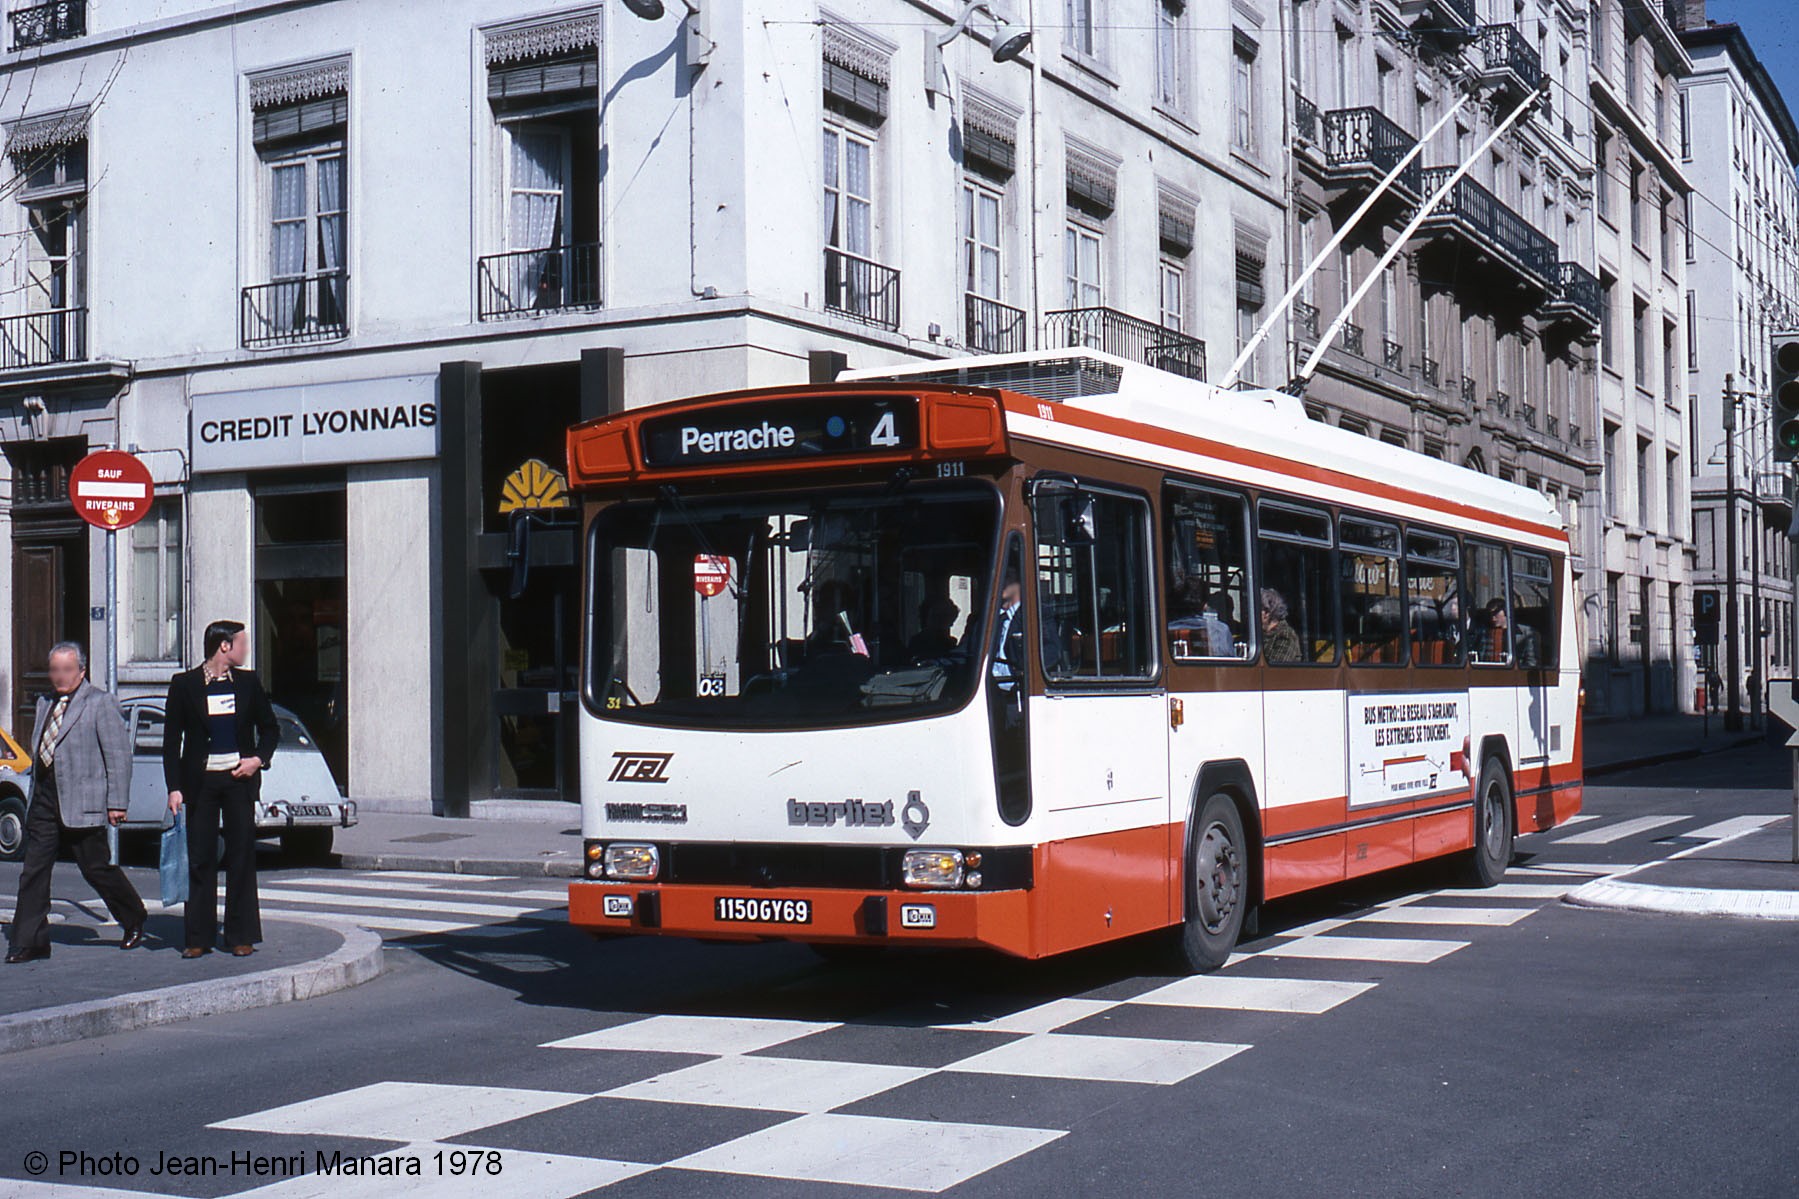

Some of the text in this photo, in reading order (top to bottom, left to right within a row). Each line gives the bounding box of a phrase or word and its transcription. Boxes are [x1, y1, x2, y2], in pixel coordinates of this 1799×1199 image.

[1037, 403, 1054, 421] 1911
[200, 402, 438, 443] CREDIT LYONNAIS
[681, 411, 900, 454] Perrache 4
[97, 469, 123, 479] SAUF
[936, 461, 966, 478] 1911
[85, 500, 135, 511] RIVERAINS
[1701, 594, 1714, 614] P
[699, 678, 724, 697] 03
[606, 697, 621, 709] 31
[1364, 706, 1376, 725] BUS
[1400, 704, 1406, 722] LE
[1407, 703, 1428, 721] RESEAU
[1375, 728, 1385, 747] LES
[1386, 726, 1415, 746] EXTREMES
[1416, 724, 1422, 743] SE
[786, 798, 895, 827] berliet
[719, 898, 808, 922] 1150GY69
